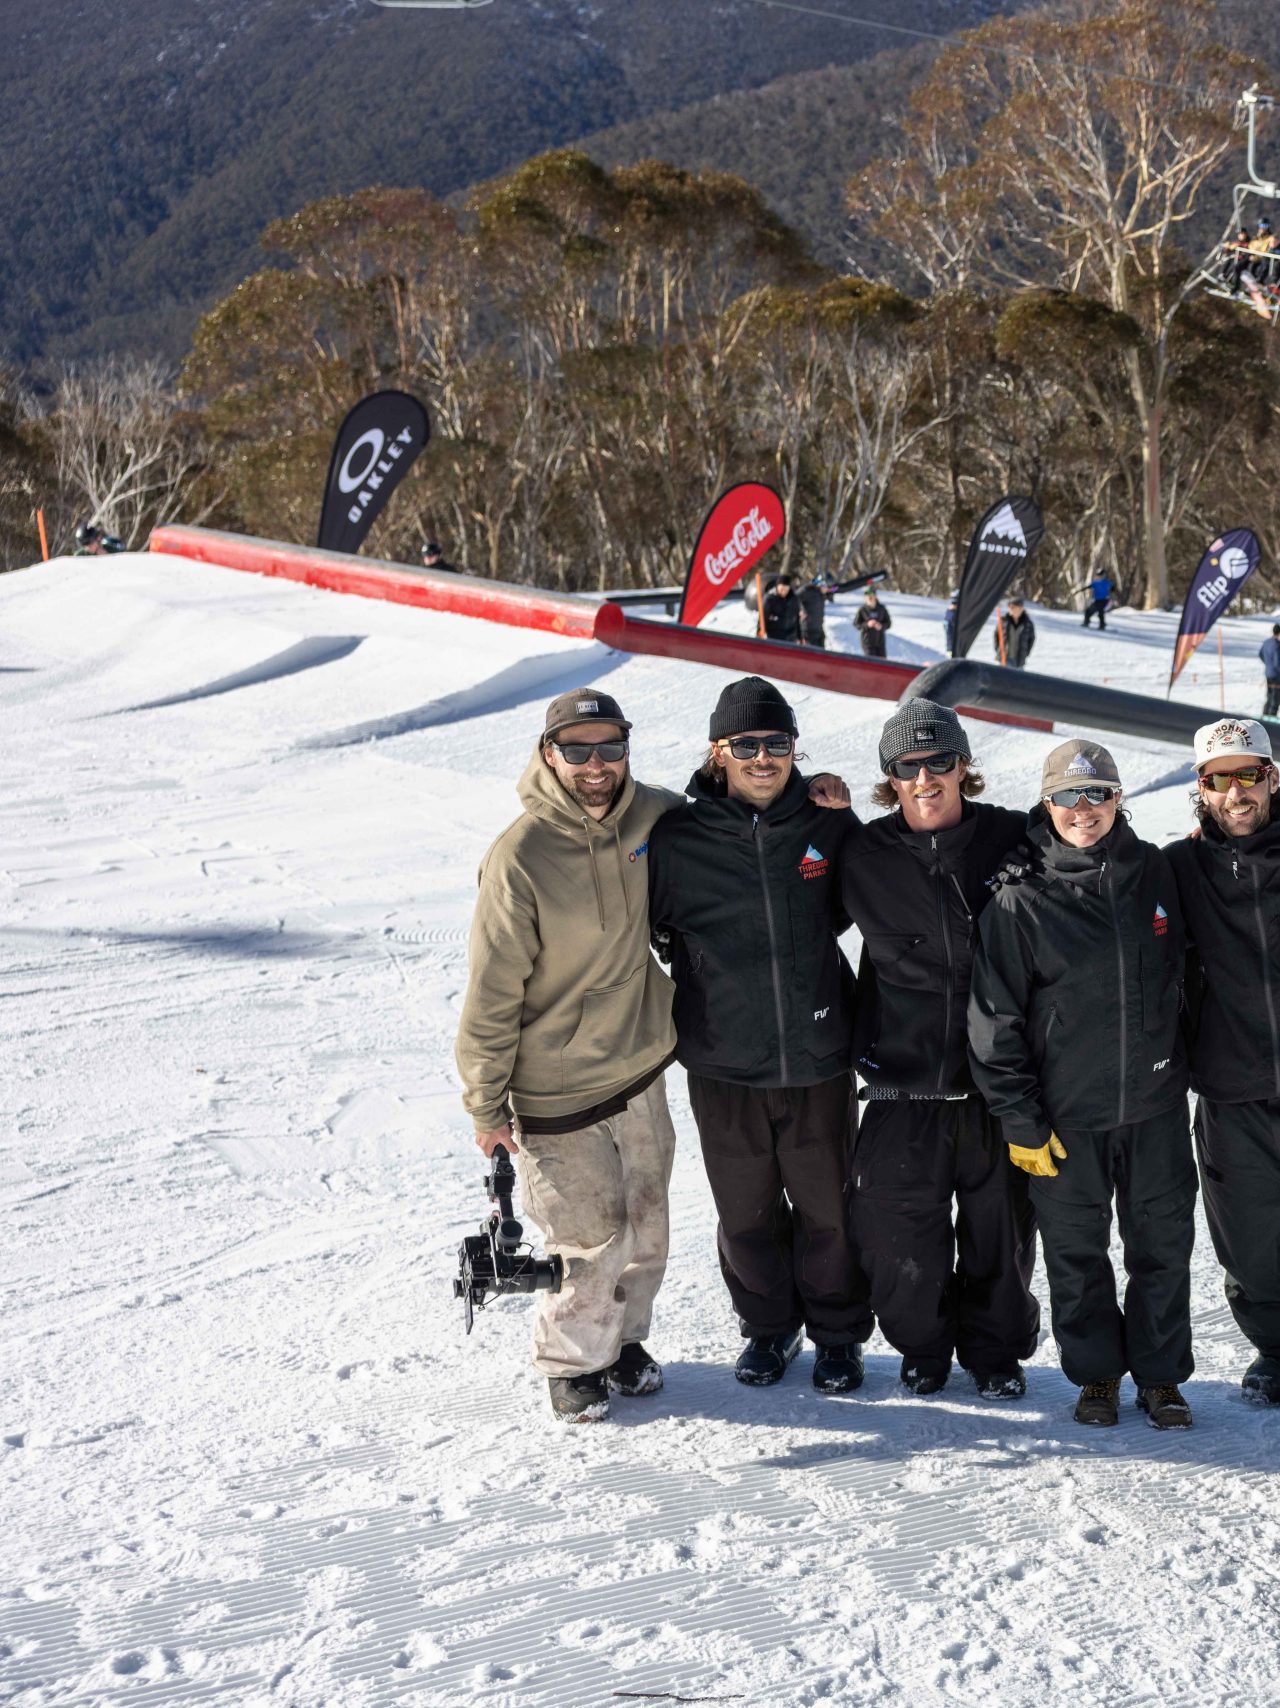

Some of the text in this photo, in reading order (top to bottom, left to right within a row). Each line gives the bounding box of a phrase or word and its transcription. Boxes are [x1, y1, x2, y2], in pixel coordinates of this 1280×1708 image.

[347, 425, 413, 524] OAKLEY
[979, 541, 1027, 558] BURTON
[1196, 576, 1229, 609] flip
[1206, 723, 1253, 753] CANNONBALL
[1063, 767, 1097, 777] THREDBO
[798, 859, 829, 874] THREDBO
[803, 868, 826, 880] PARKS
